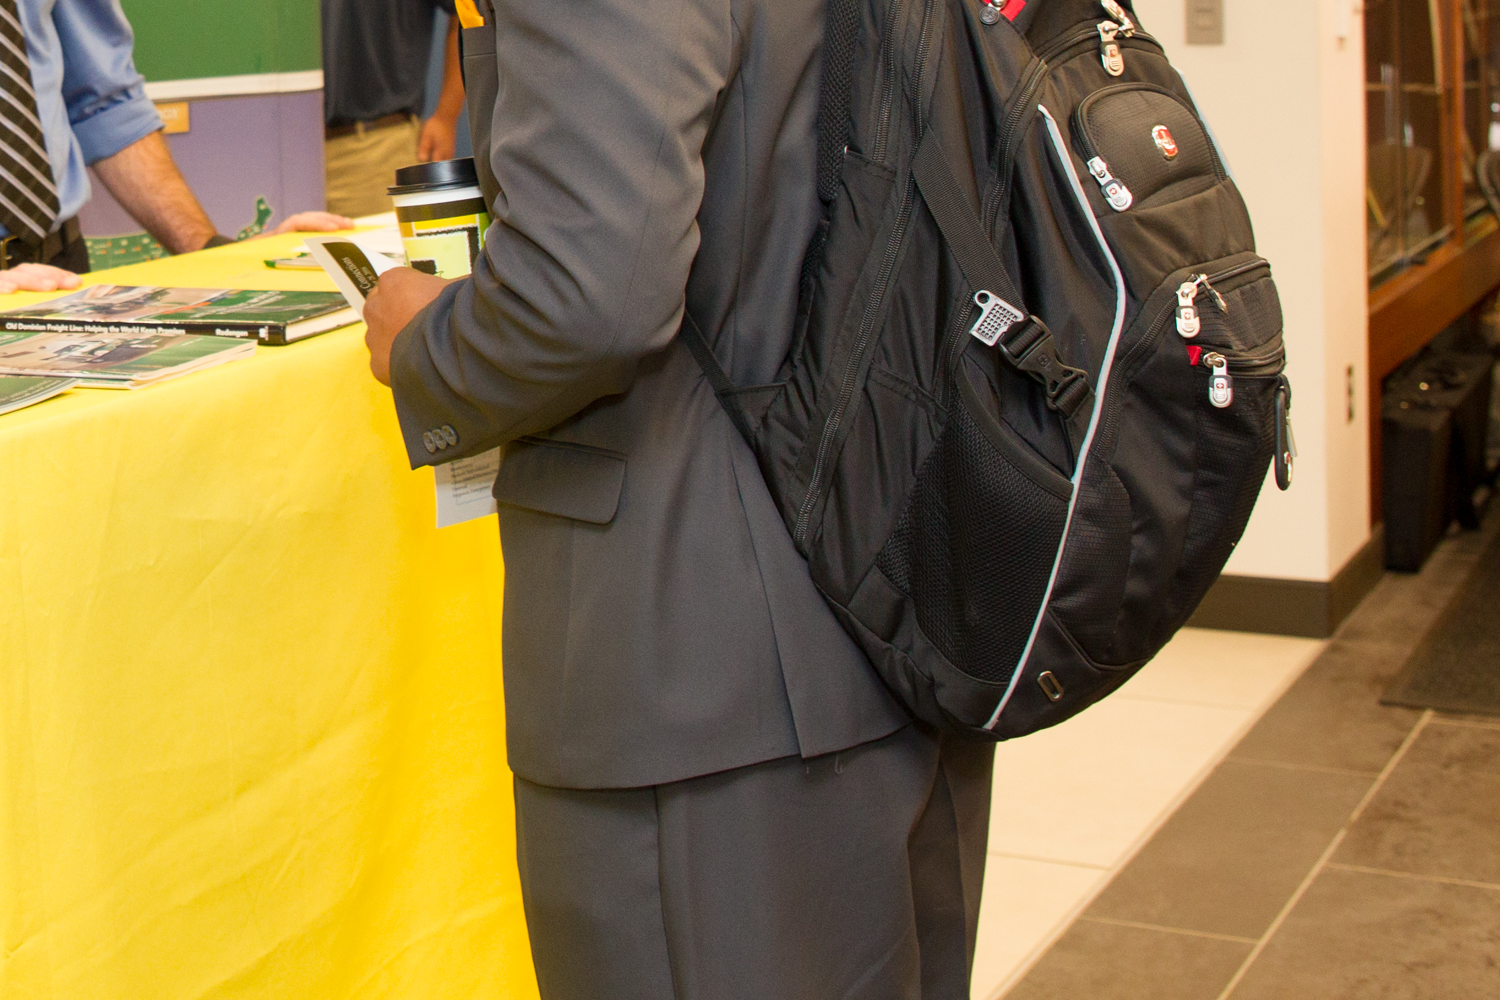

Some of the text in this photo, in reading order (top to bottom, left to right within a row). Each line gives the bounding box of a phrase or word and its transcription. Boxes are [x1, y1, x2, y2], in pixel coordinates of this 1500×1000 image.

[5, 321, 18, 330] Old
[18, 321, 47, 331] Dominion
[47, 322, 69, 333] Freight
[84, 324, 108, 334] Helping
[109, 325, 120, 333] the
[120, 325, 140, 334] World
[157, 326, 186, 335] Promises
